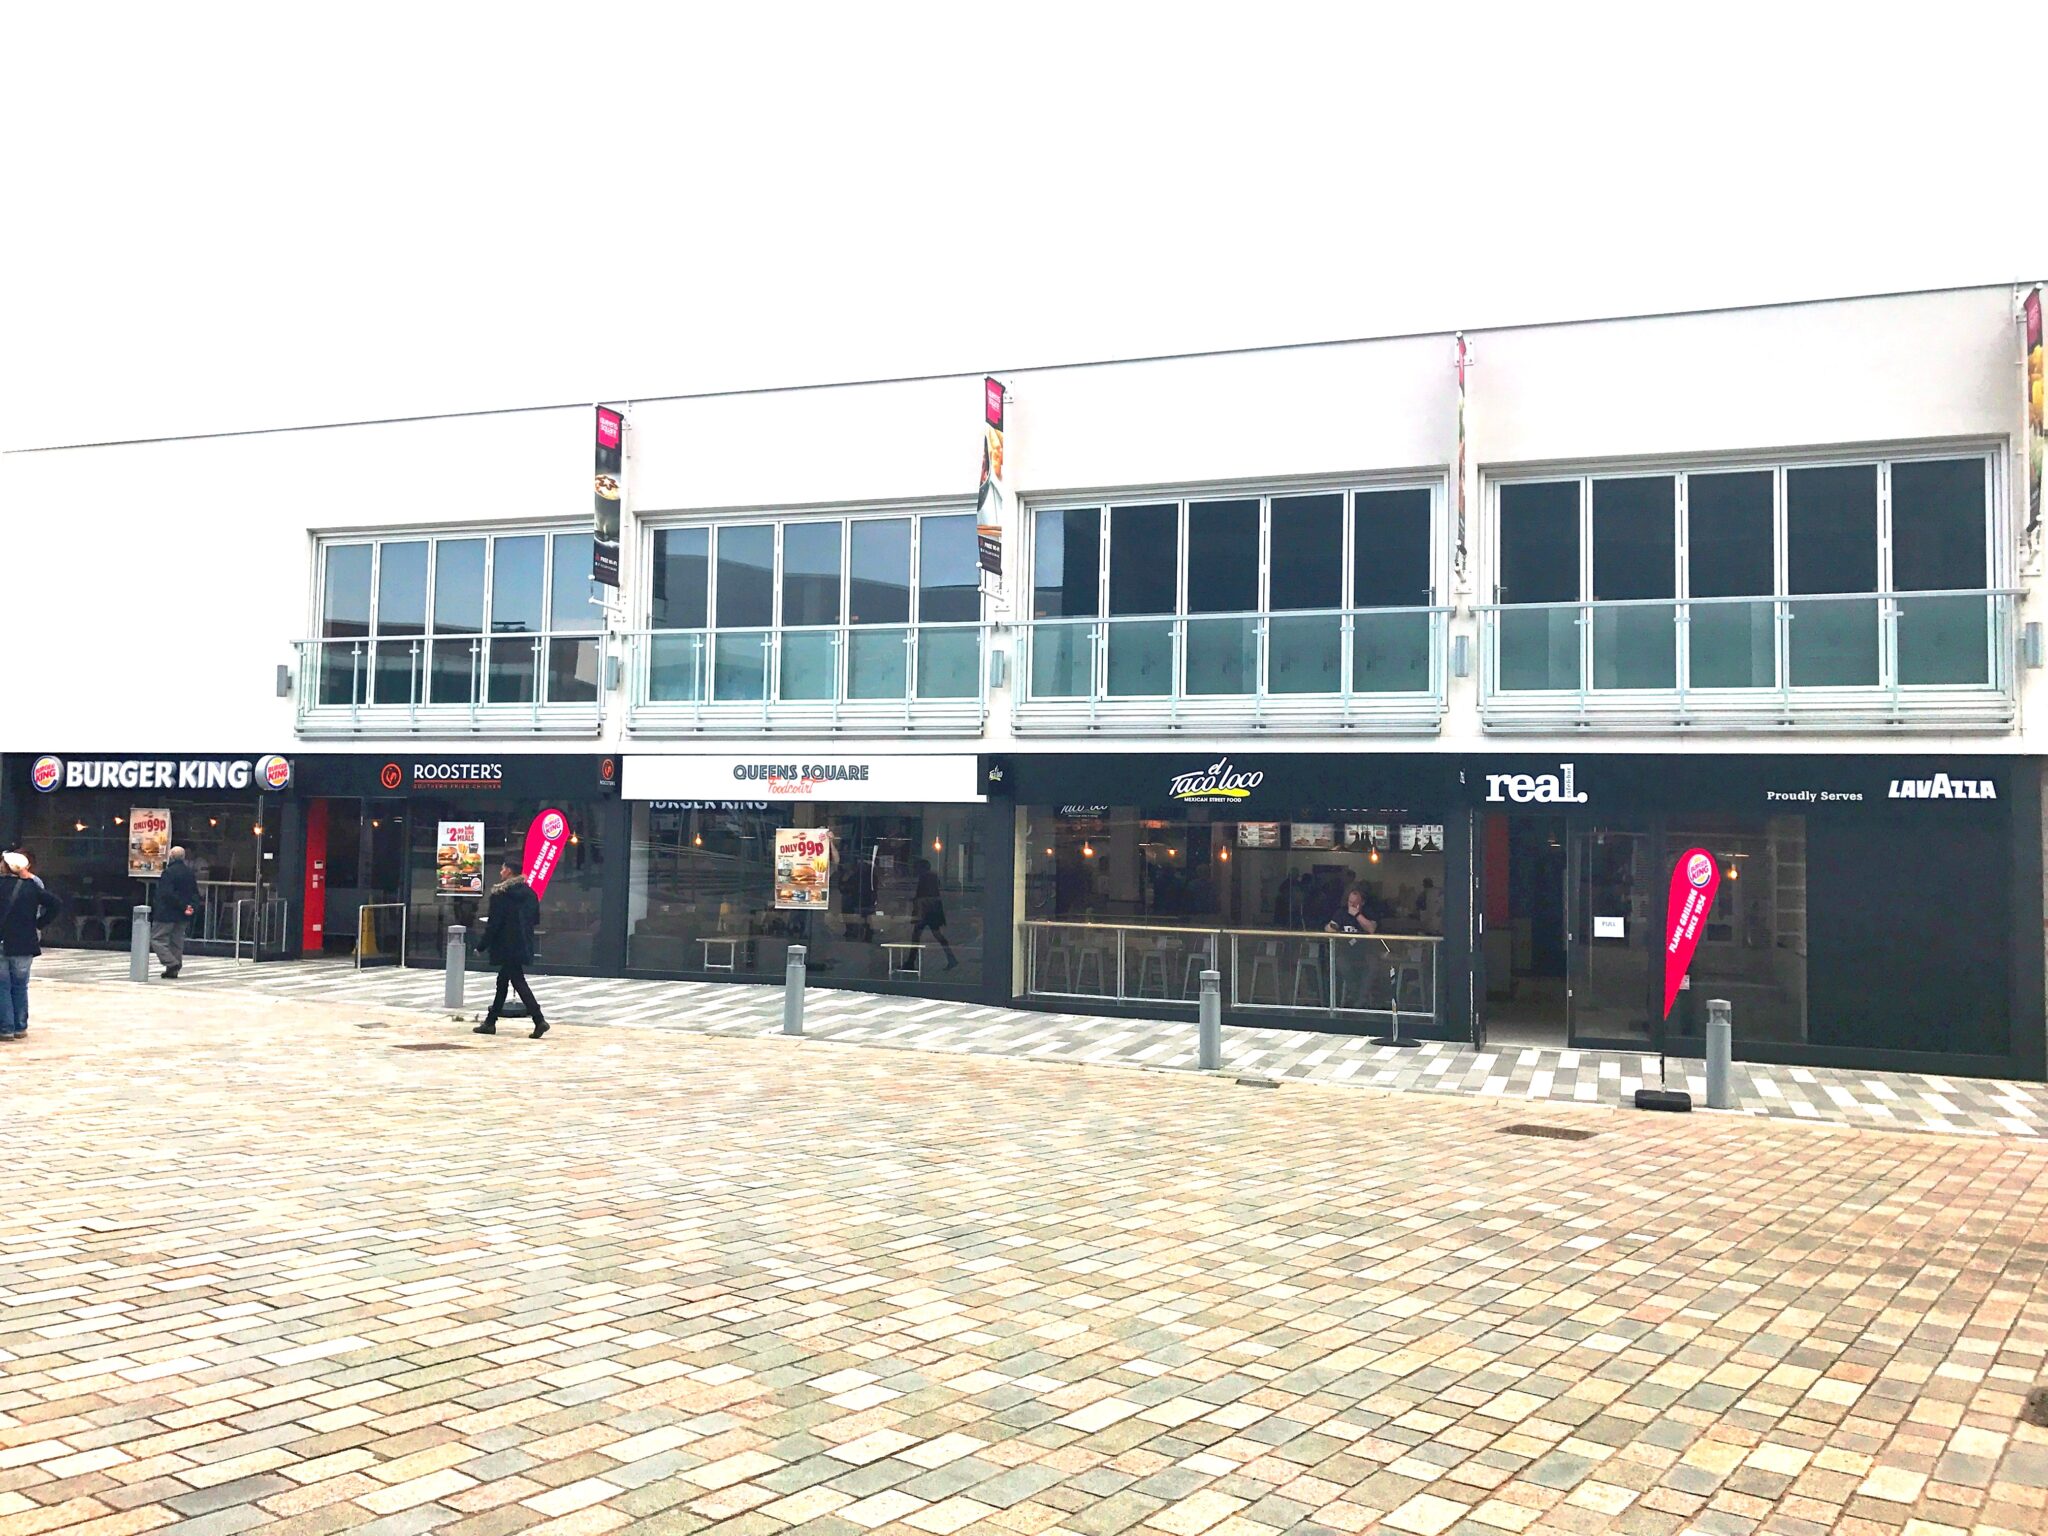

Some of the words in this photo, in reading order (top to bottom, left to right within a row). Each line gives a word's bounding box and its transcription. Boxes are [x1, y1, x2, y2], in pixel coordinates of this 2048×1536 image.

[66, 760, 176, 788] BURGER
[179, 760, 252, 788] KING
[267, 768, 288, 781] KING
[413, 764, 502, 779] ROOSTER'S
[733, 765, 798, 780] QUEENS
[801, 765, 869, 780] SQUARE
[1208, 757, 1227, 775] el
[35, 769, 56, 783] KING
[1169, 771, 1216, 795] Taco
[1219, 765, 1264, 790] loco
[1485, 763, 1588, 803] real.
[1888, 773, 1997, 799] LAVAZZA
[1767, 791, 1816, 802] Proudly
[1820, 791, 1863, 801] Serves
[147, 818, 166, 832] 99p
[546, 822, 561, 834] KING
[533, 840, 551, 871] GRILLING
[780, 843, 798, 854] ONLY
[798, 840, 824, 856] 99p
[538, 861, 551, 881] SINCE
[1691, 865, 1709, 880] KING
[1669, 925, 1685, 953] FLAME
[1680, 888, 1698, 926] GRILLING
[1685, 914, 1699, 940] SINCE
[1694, 893, 1707, 915] 1954
